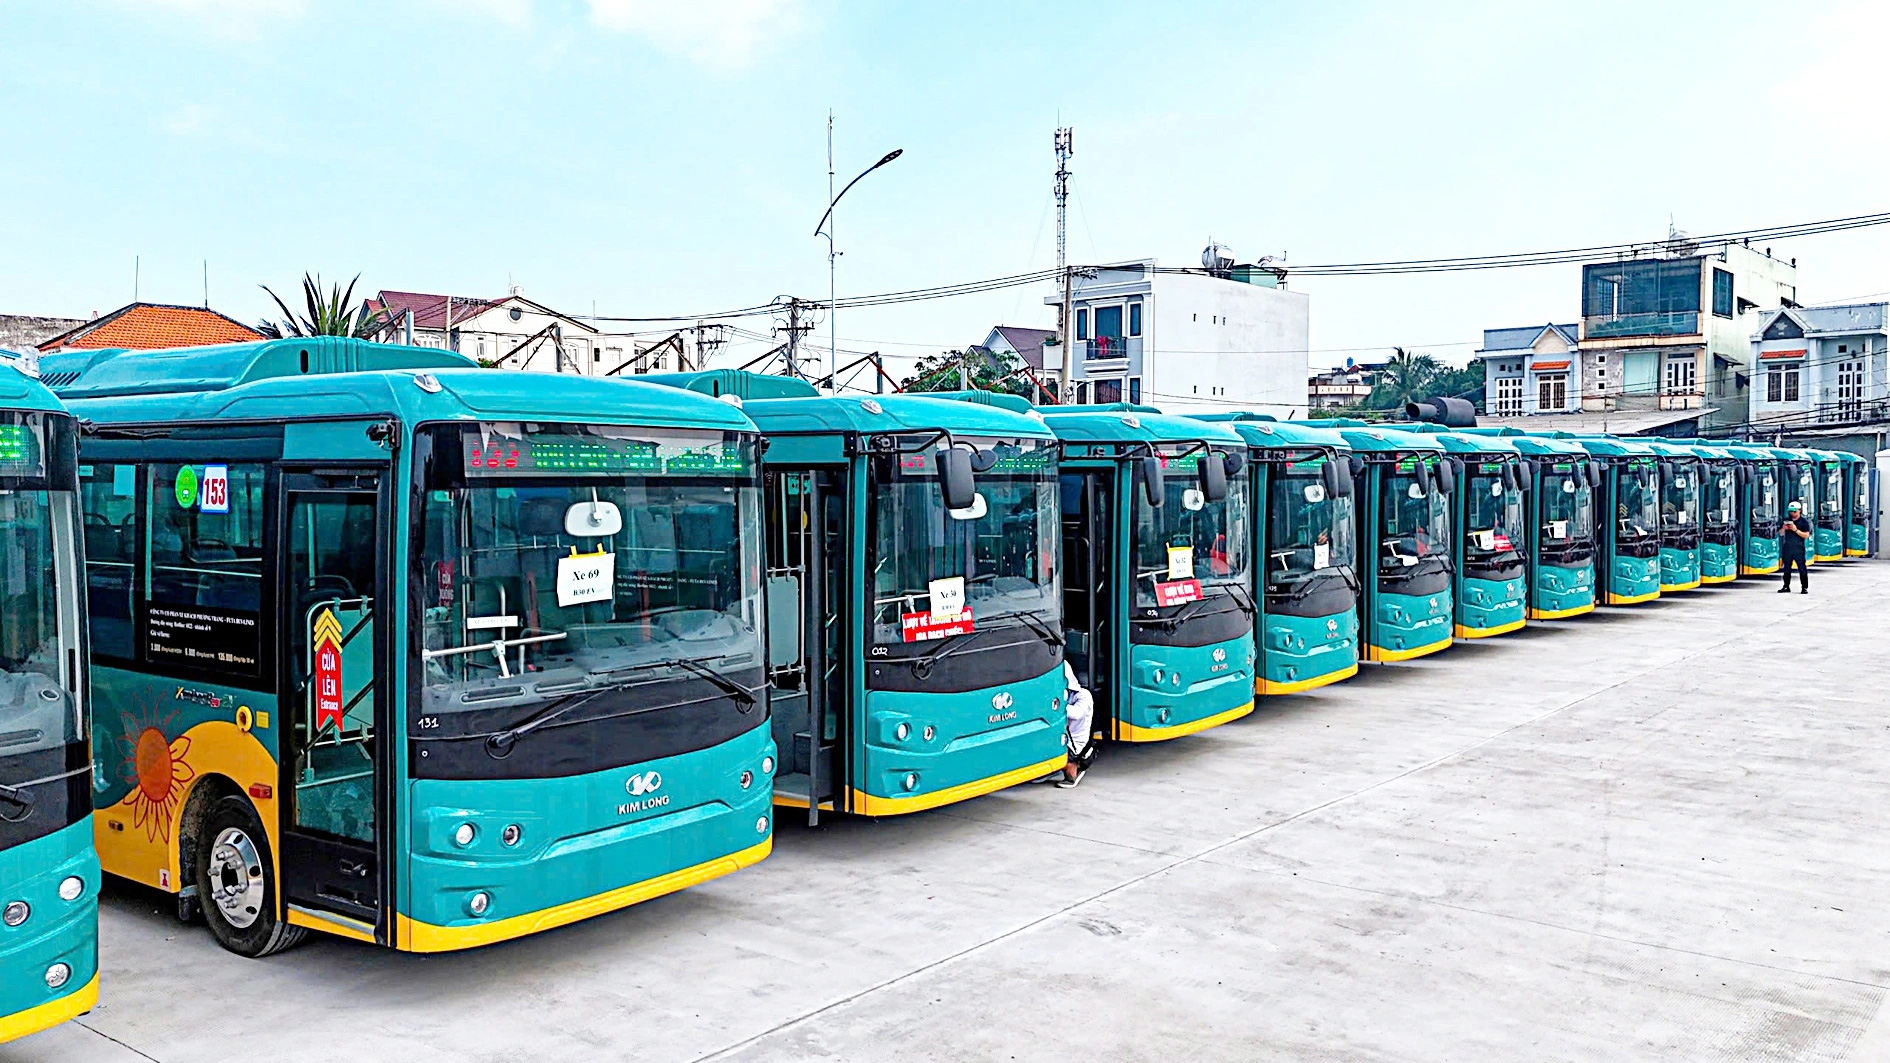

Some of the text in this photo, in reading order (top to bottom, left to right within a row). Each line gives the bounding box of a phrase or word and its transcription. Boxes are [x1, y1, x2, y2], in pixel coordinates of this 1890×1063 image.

[204, 478, 226, 505] 153
[572, 568, 599, 581] Xe 69
[321, 648, 336, 671] CỬA
[322, 675, 336, 696] LÊN
[320, 698, 338, 711] Entrance
[417, 717, 440, 729] 131
[618, 795, 670, 815] KIM LONG
